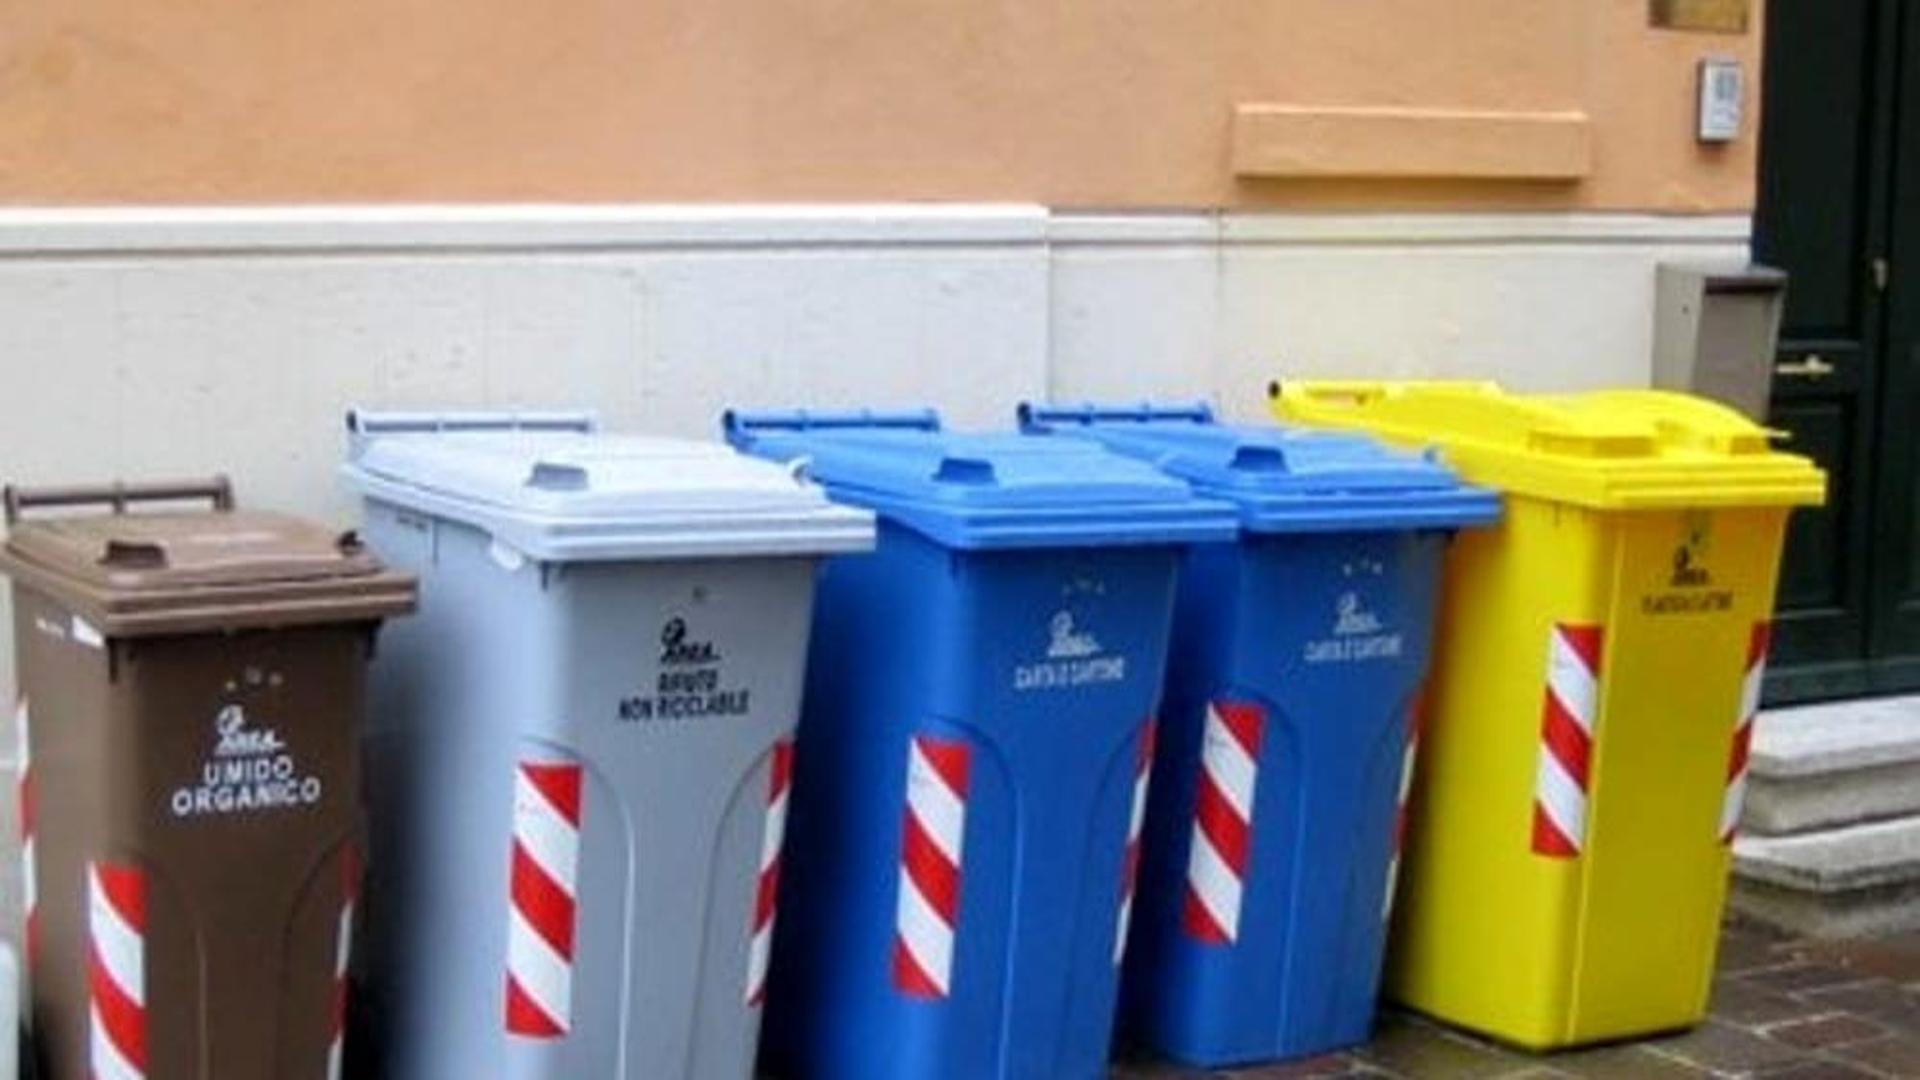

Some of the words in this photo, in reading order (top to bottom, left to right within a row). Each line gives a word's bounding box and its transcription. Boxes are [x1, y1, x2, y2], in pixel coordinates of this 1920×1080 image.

[619, 696, 652, 721] NON
[204, 755, 293, 786] UMIDO
[171, 776, 321, 817] ORGANICO
